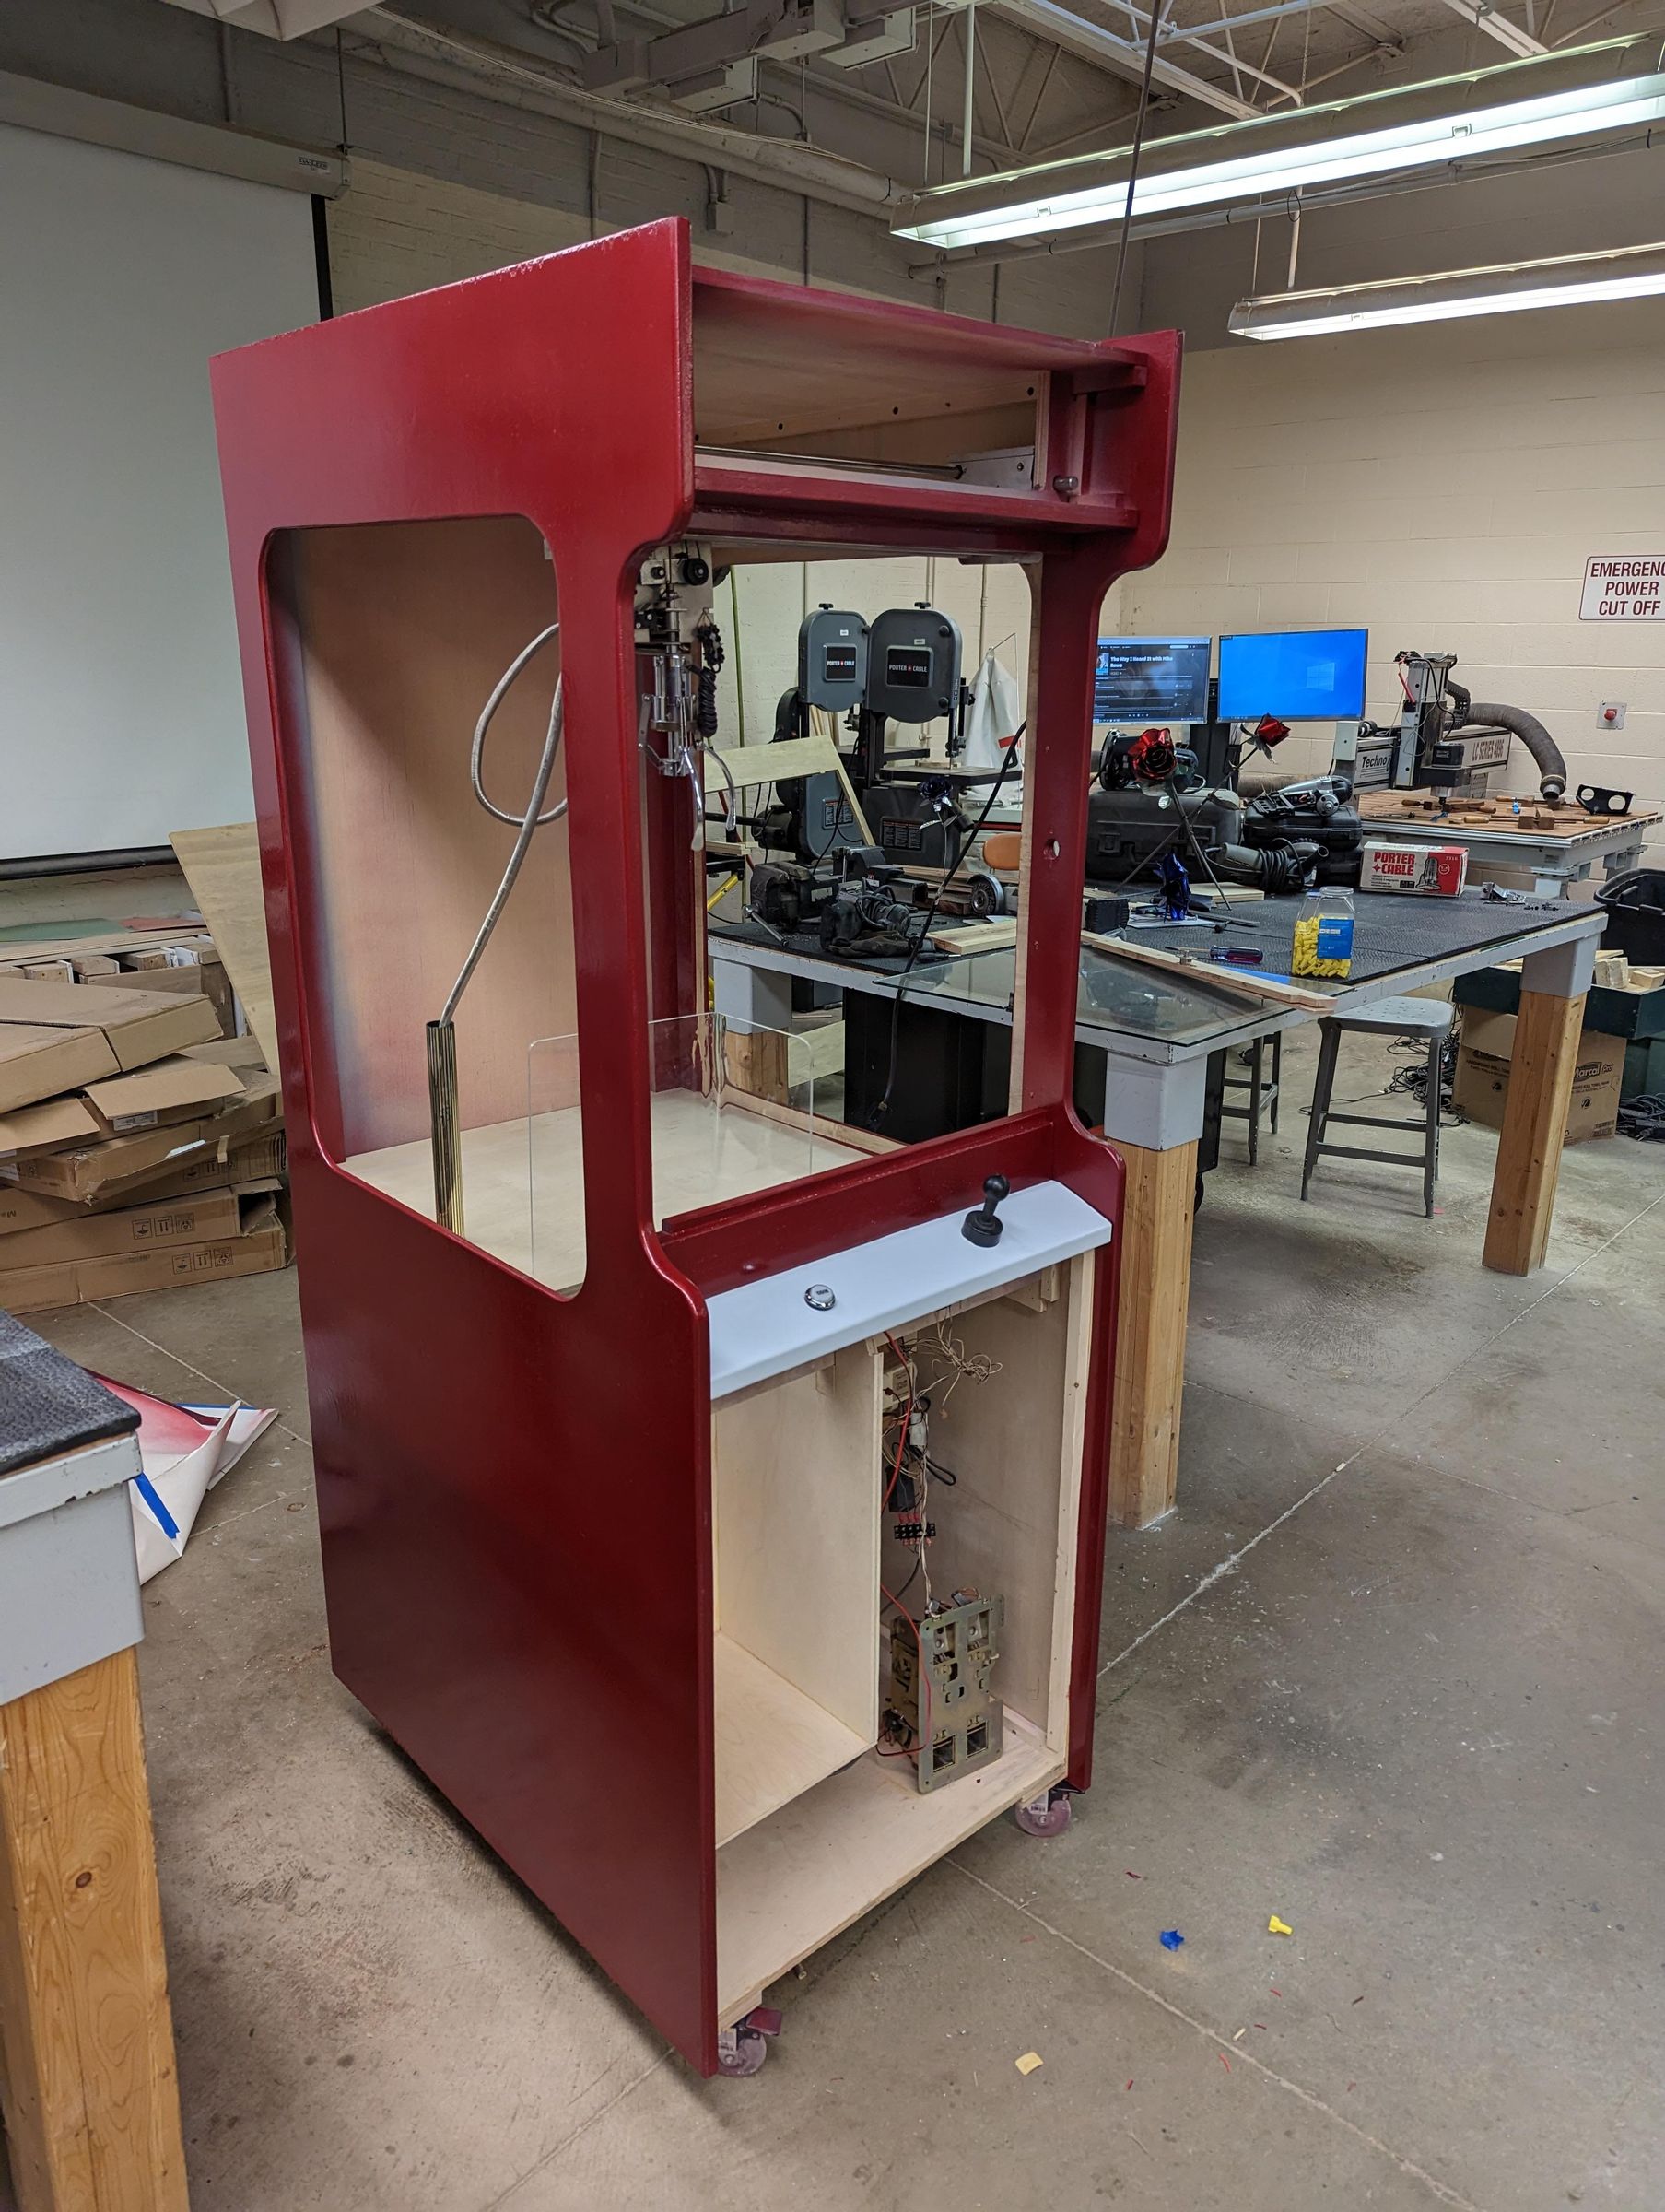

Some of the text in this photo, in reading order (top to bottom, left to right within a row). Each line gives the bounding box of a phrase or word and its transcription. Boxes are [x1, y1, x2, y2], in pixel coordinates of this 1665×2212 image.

[1605, 582, 1659, 596] POWER
[1599, 600, 1661, 616] CUT OFF
[1479, 740, 1495, 760] SERIES
[1362, 753, 1388, 769] Techno
[1373, 851, 1416, 865] PORTER
[1381, 863, 1414, 876] CABLE
[1603, 1064, 1613, 1072] Pro
